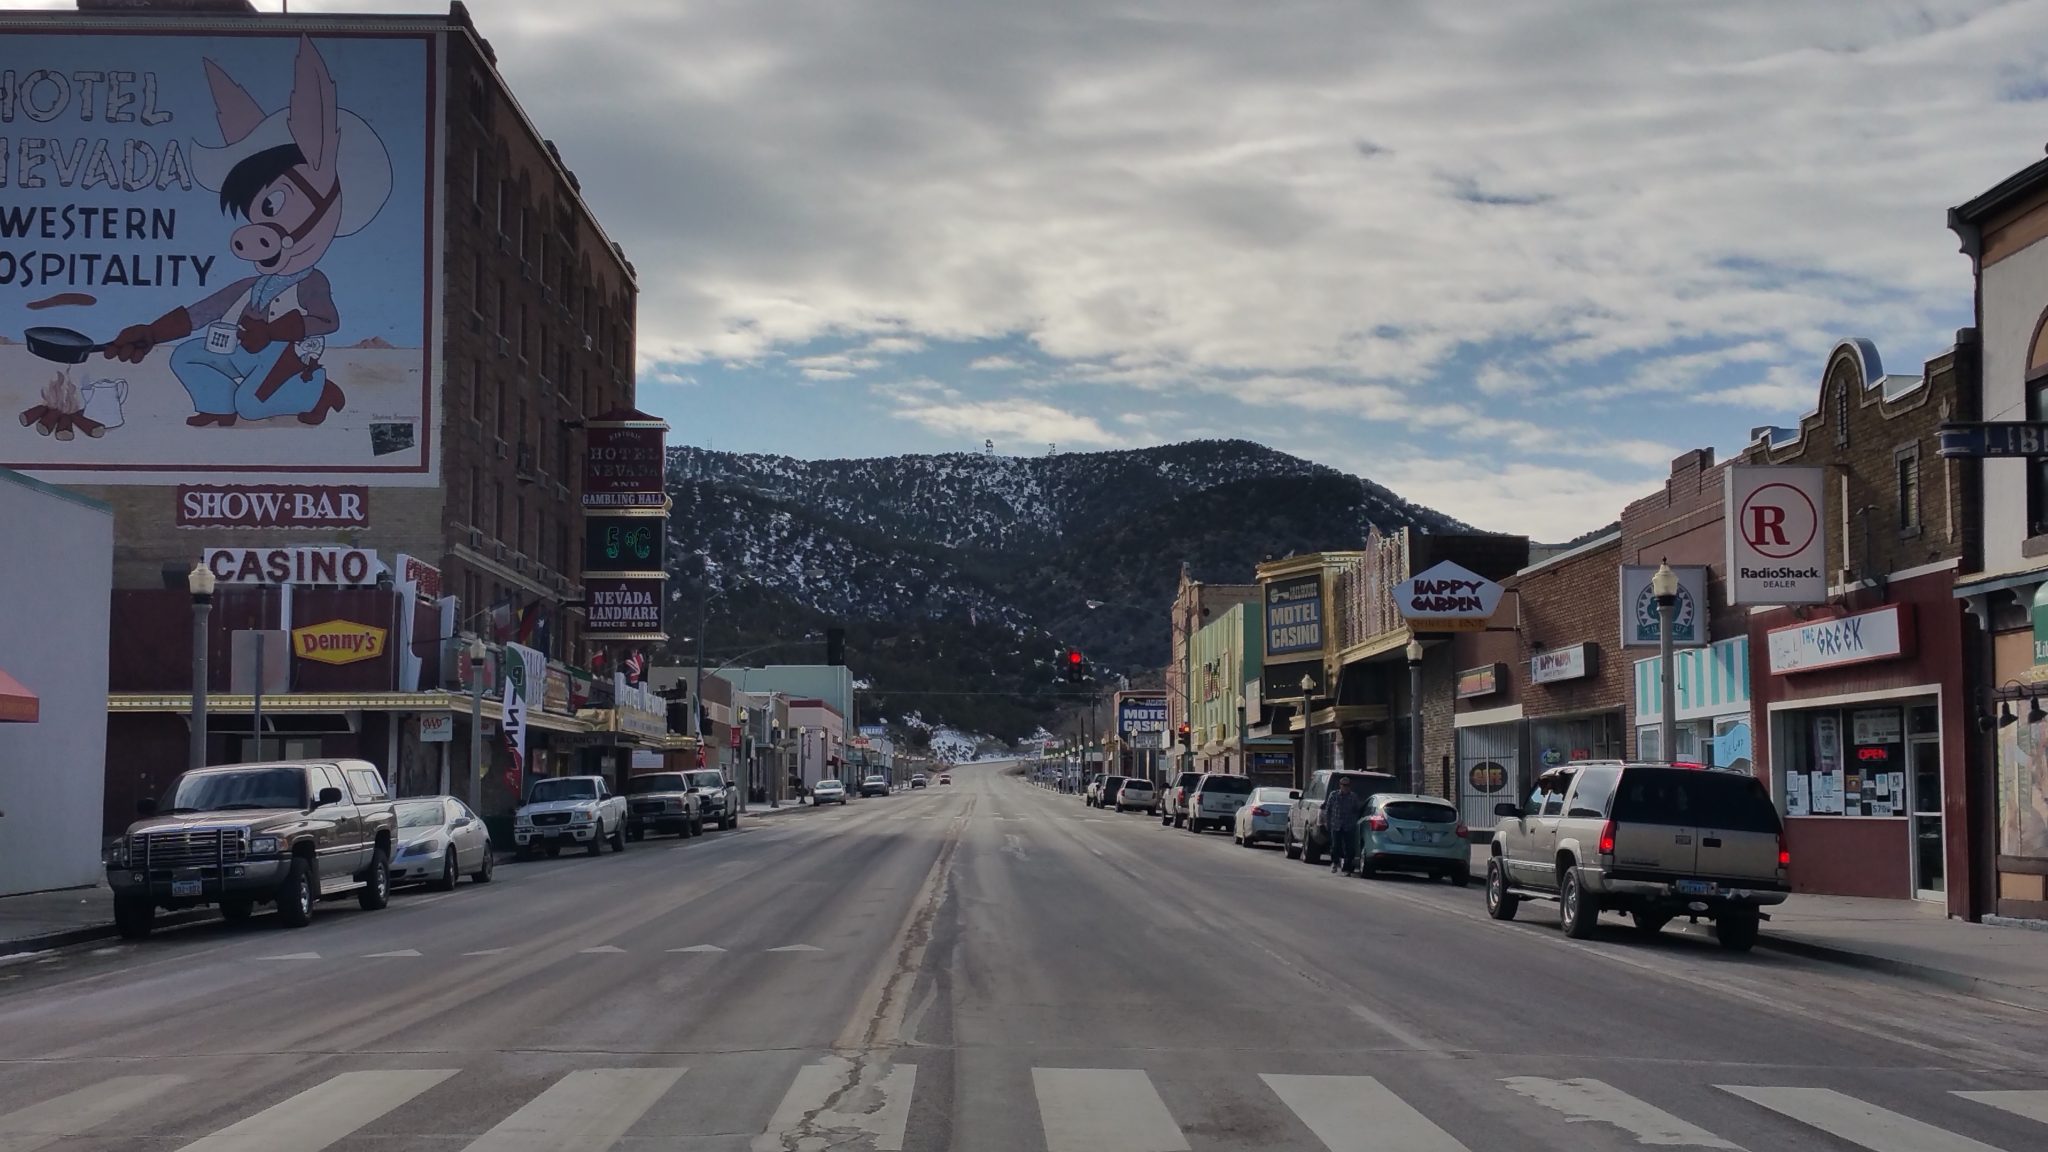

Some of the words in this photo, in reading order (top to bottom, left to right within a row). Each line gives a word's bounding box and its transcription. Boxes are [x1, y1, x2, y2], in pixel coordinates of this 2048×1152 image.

[0, 203, 176, 241] WESTERN
[590, 447, 659, 461] HOTEL
[582, 493, 636, 505] GAMBLING
[637, 493, 665, 505] HALL
[210, 550, 368, 582] CASINO
[1740, 567, 1818, 579] RadioShack
[619, 583, 628, 591] A
[1414, 579, 1485, 595] HAPPY
[1763, 580, 1796, 588] DEALER
[594, 591, 653, 605] NEVADA
[1411, 596, 1484, 612] GARDEN
[589, 606, 659, 620] LANDMARK
[1271, 602, 1318, 626] MOTEL
[302, 632, 377, 654] Denny's
[1271, 623, 1320, 649] CASINO
[1816, 616, 1864, 656] GREEK
[1858, 747, 1887, 760] OPEN
